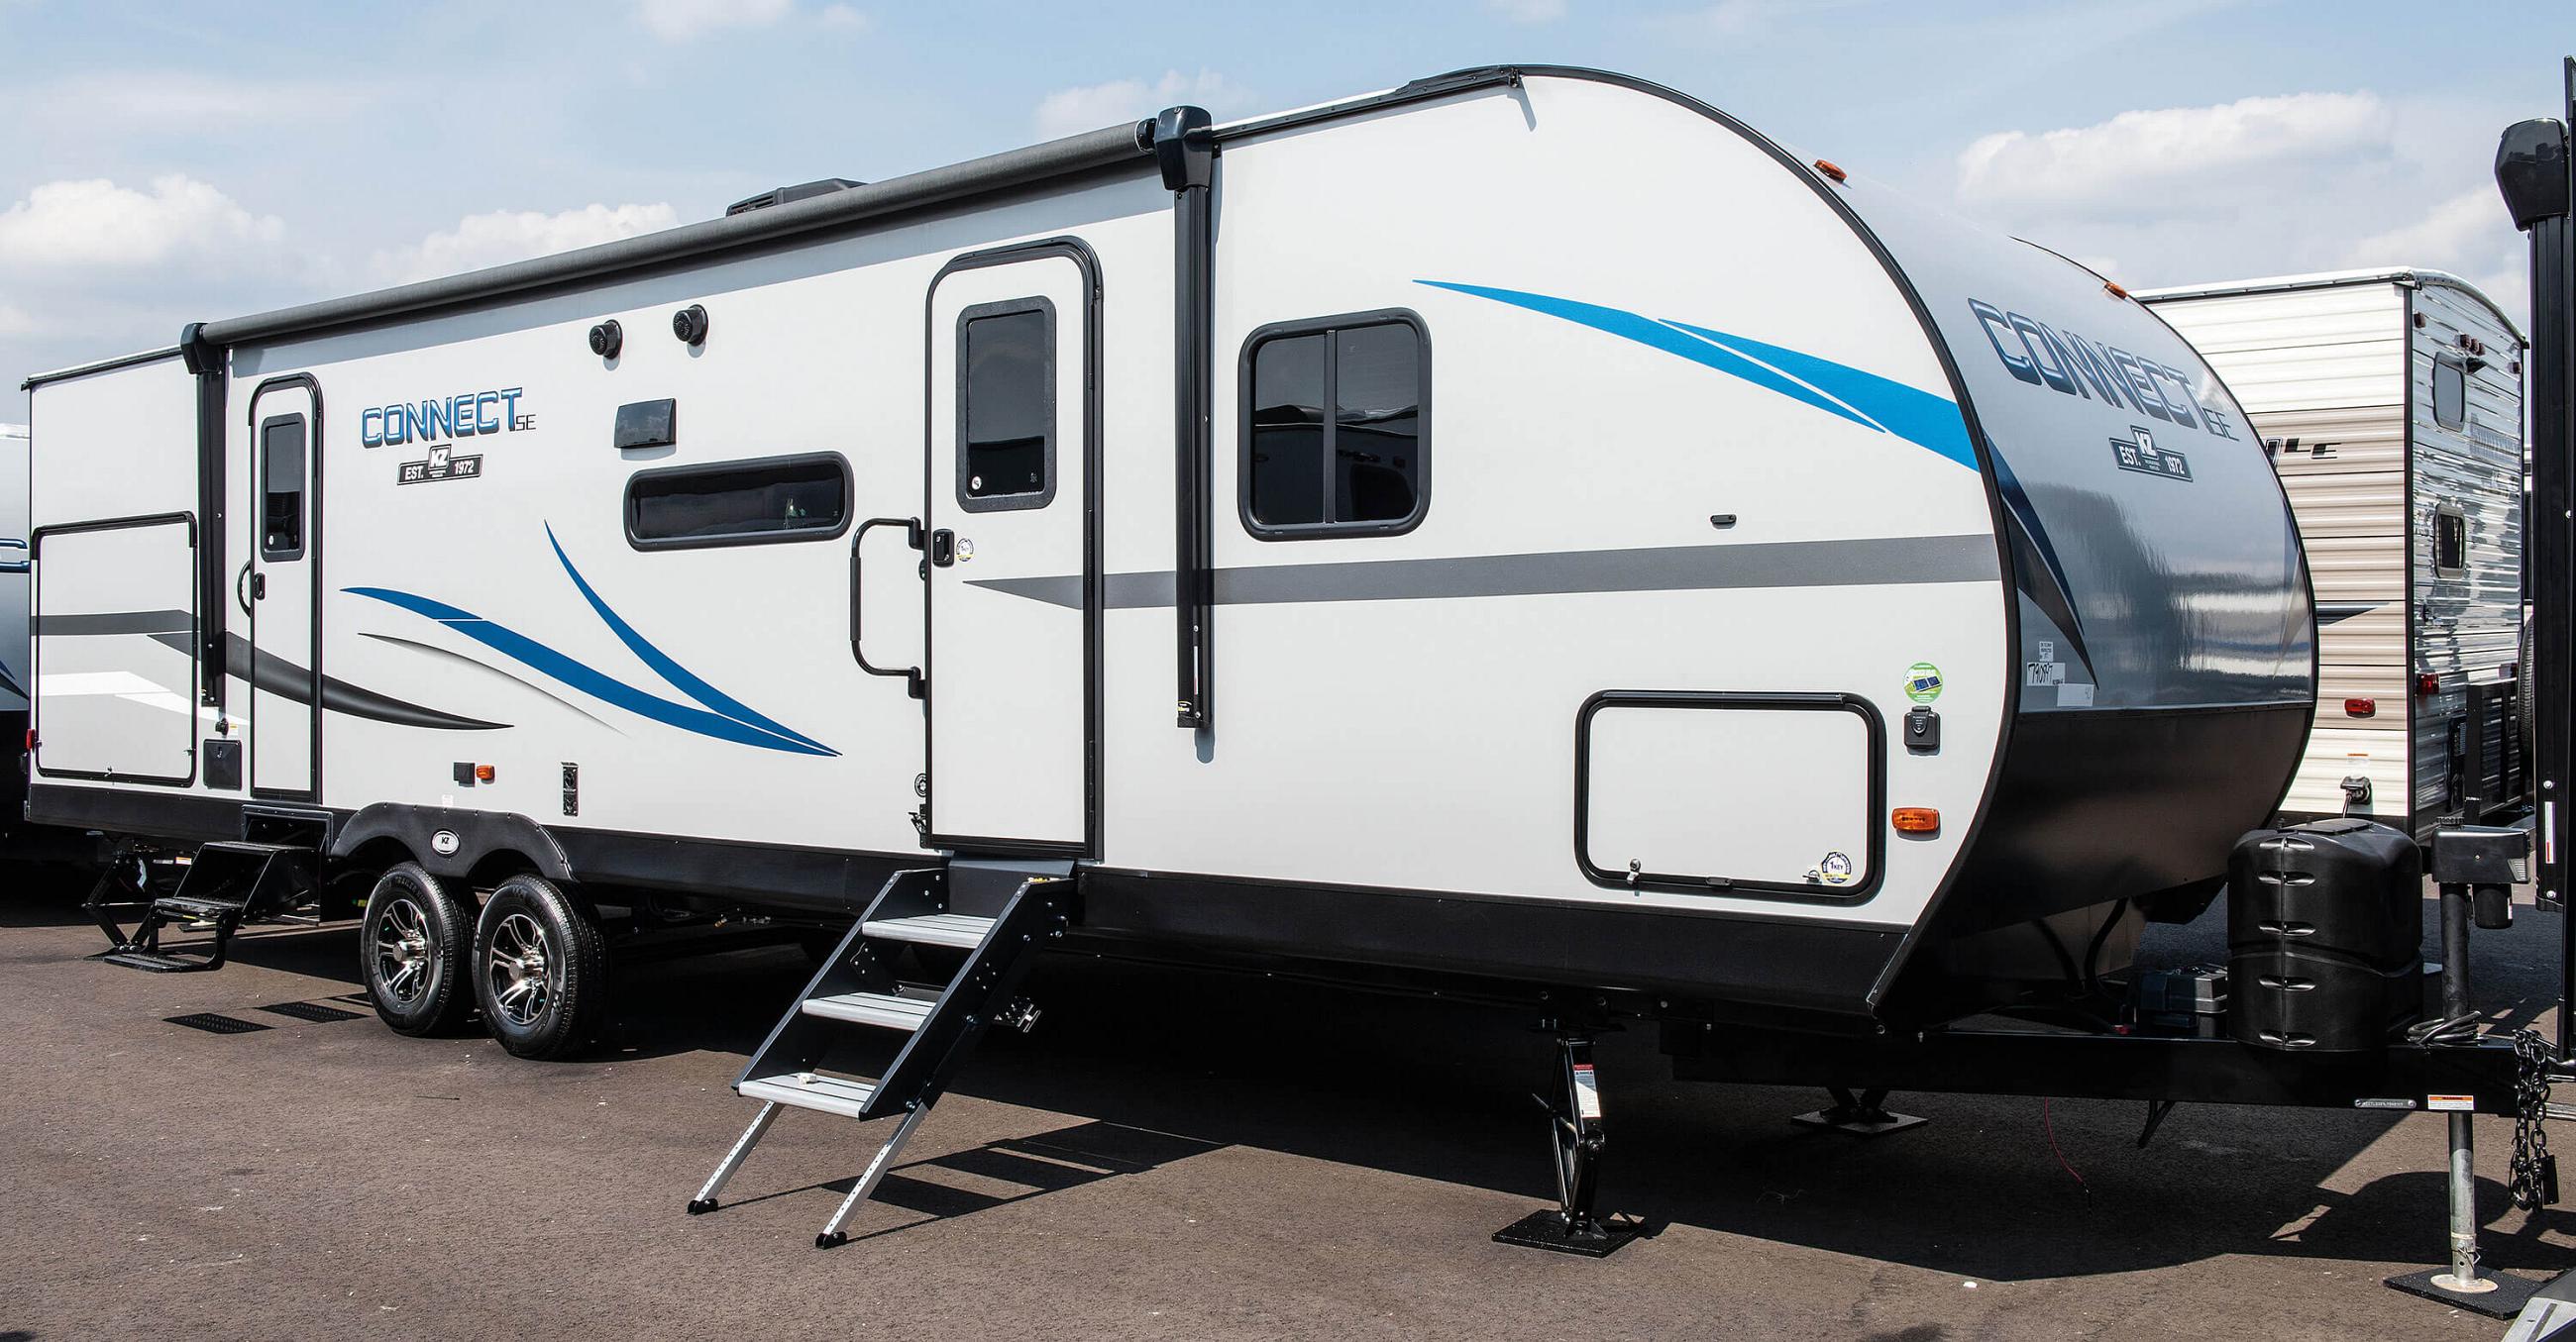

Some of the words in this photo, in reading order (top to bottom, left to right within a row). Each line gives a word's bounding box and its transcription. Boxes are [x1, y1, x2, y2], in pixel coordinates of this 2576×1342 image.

[1968, 298, 2214, 434] CONNECT
[362, 386, 522, 449] CONNECT
[515, 414, 537, 432] SE
[2134, 431, 2157, 457] KZ
[404, 465, 424, 480] EST.
[454, 460, 475, 474] 1972
[430, 449, 449, 467] KZ
[2118, 445, 2142, 466] EST.
[2165, 456, 2186, 474] 1972
[441, 836, 450, 845] KZ
